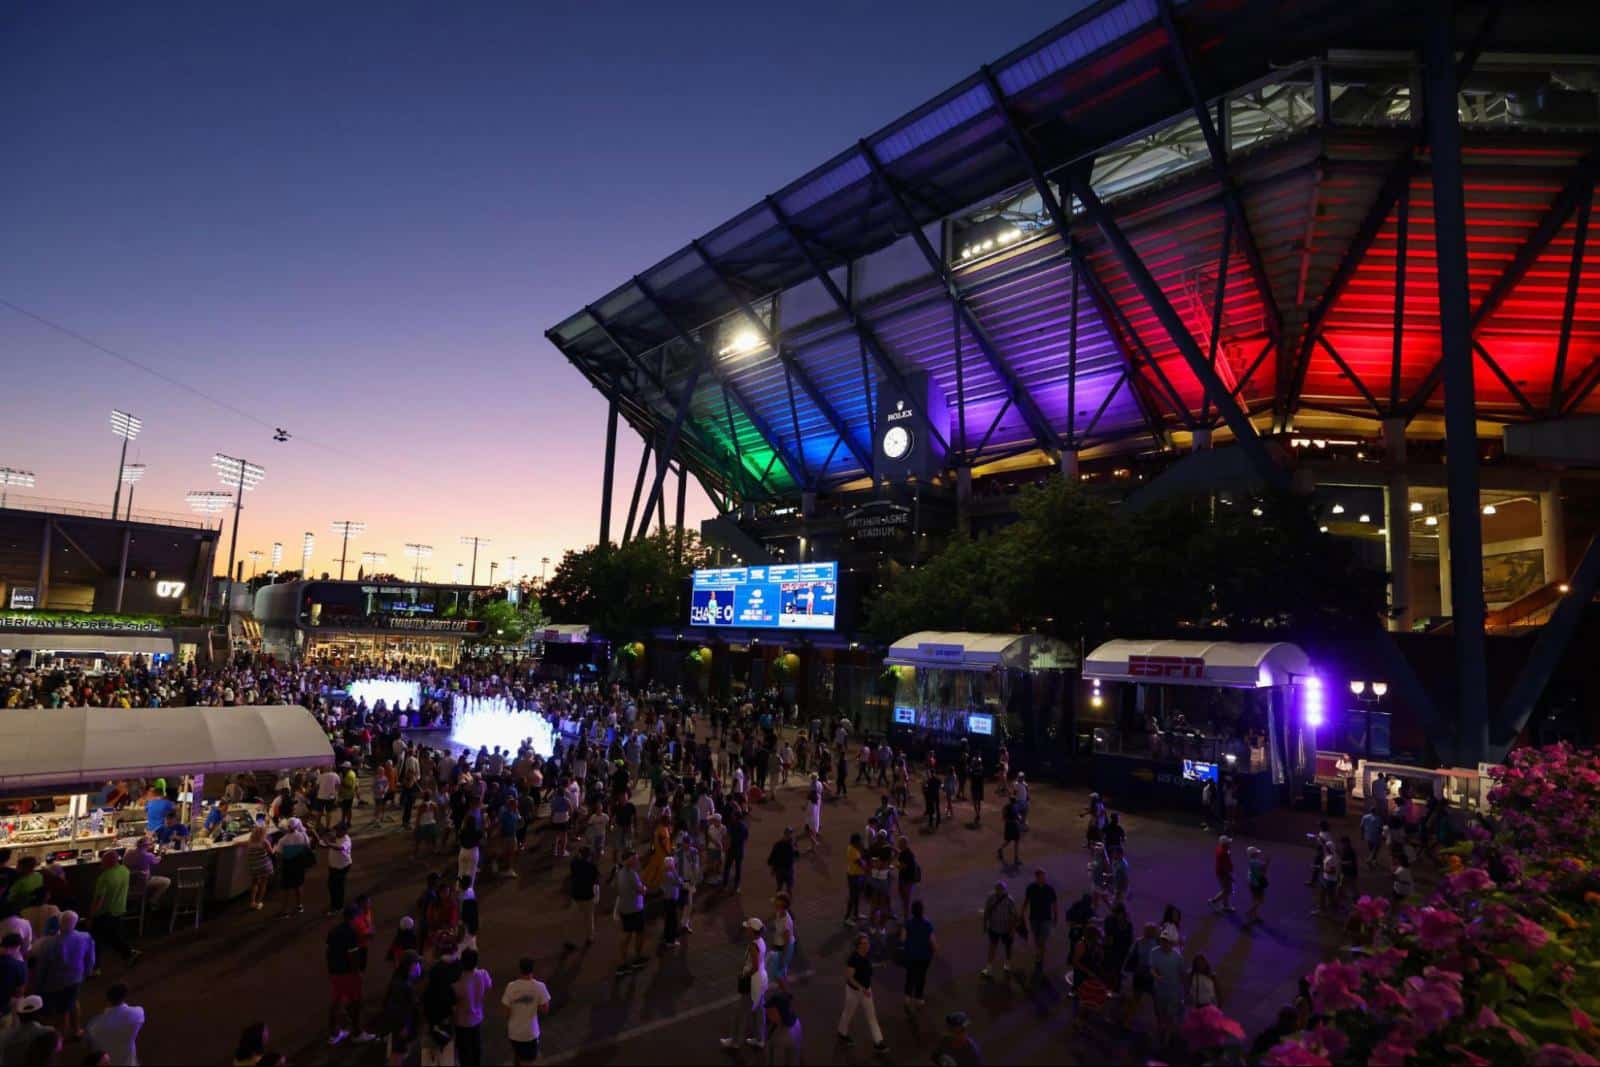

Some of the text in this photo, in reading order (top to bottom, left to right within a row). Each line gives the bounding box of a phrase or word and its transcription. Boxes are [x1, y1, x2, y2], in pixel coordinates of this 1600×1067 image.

[887, 409, 913, 421] ROLEX
[156, 581, 185, 598] 07
[691, 606, 723, 619] CHAE
[63, 620, 123, 631] EXPRESS
[1128, 655, 1206, 678] ESPN
